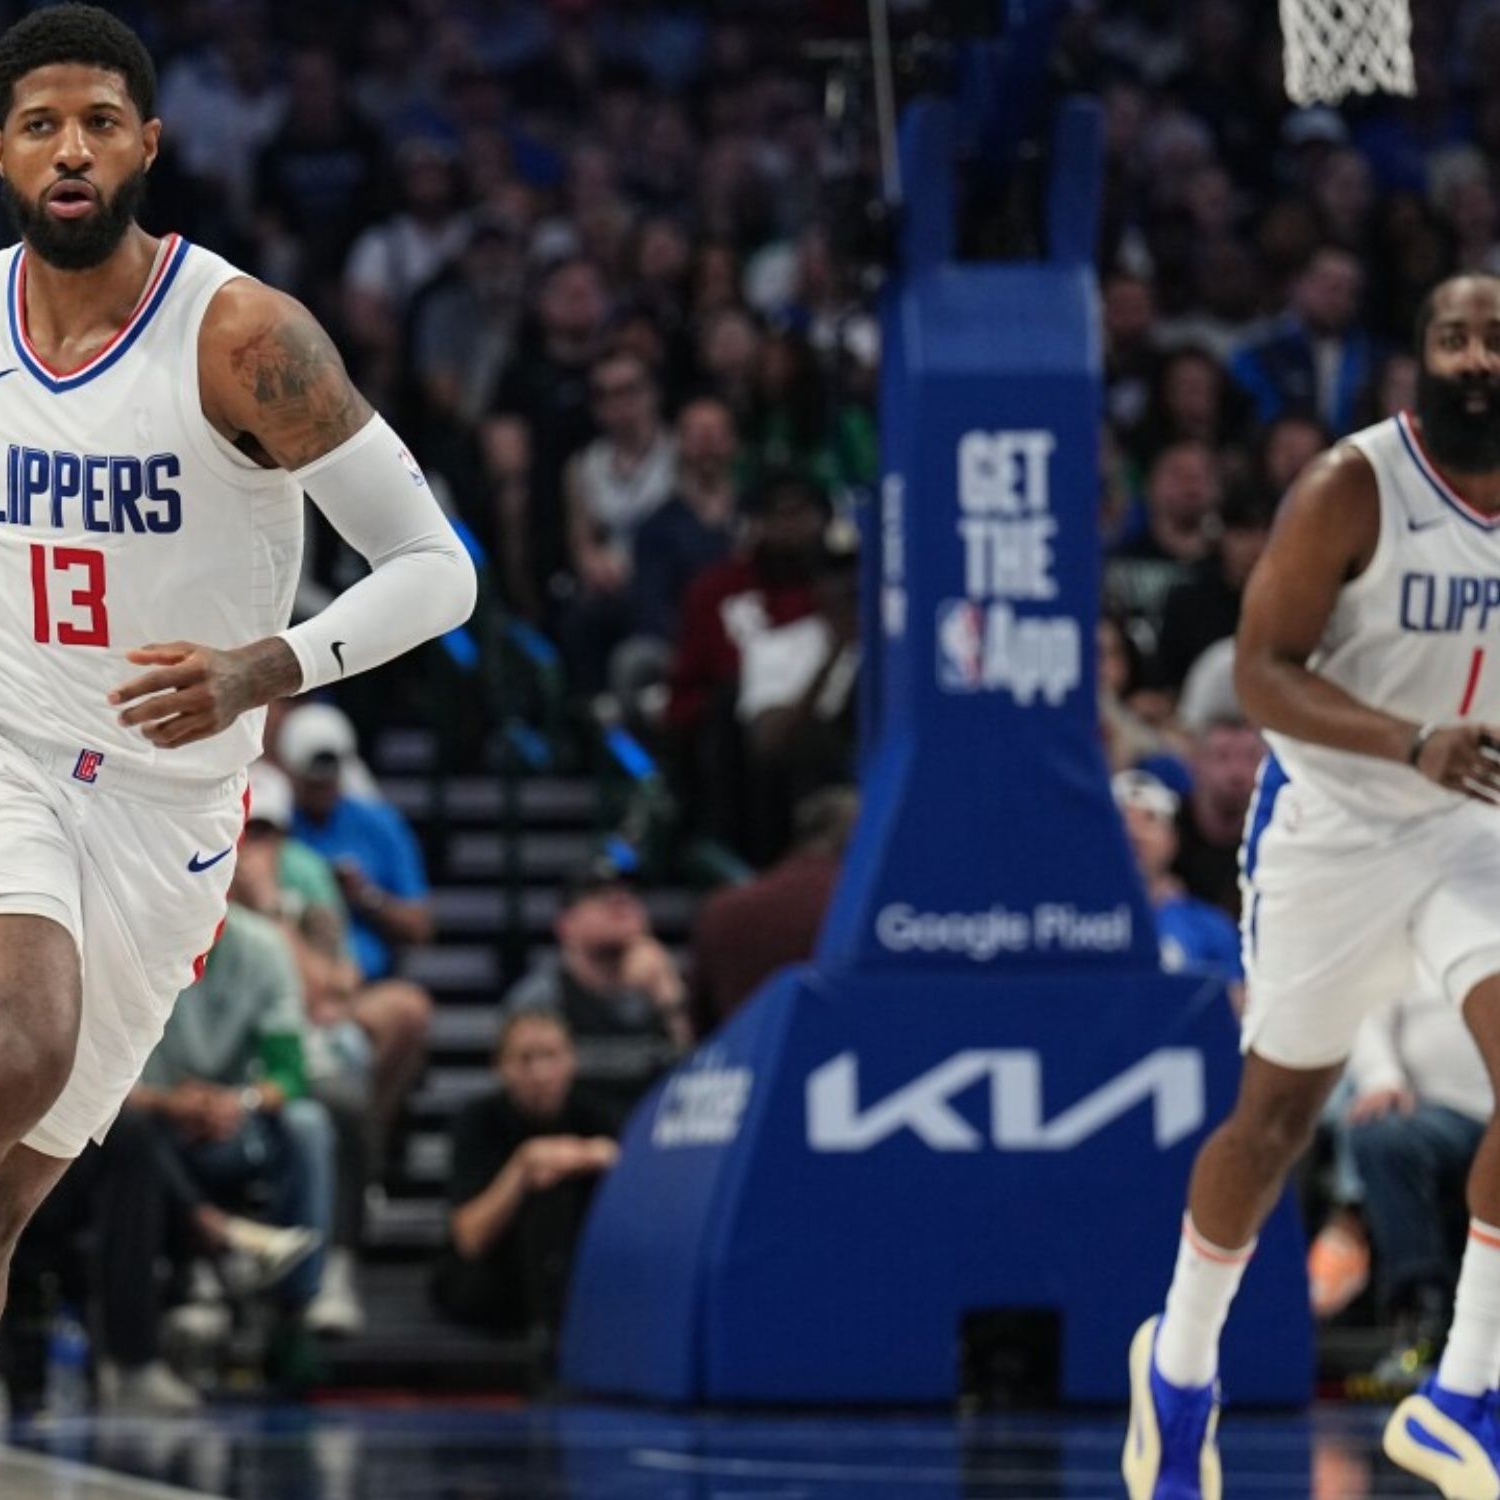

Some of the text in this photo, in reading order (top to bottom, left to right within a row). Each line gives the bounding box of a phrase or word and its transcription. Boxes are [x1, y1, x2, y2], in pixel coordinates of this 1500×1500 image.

[957, 429, 1056, 514] GET
[29, 543, 109, 647] 13
[958, 517, 1059, 600] THE
[986, 601, 1081, 706] App
[1458, 646, 1484, 717] 1
[875, 902, 1132, 962] Google Pixel
[805, 1046, 1206, 1152] KIA
